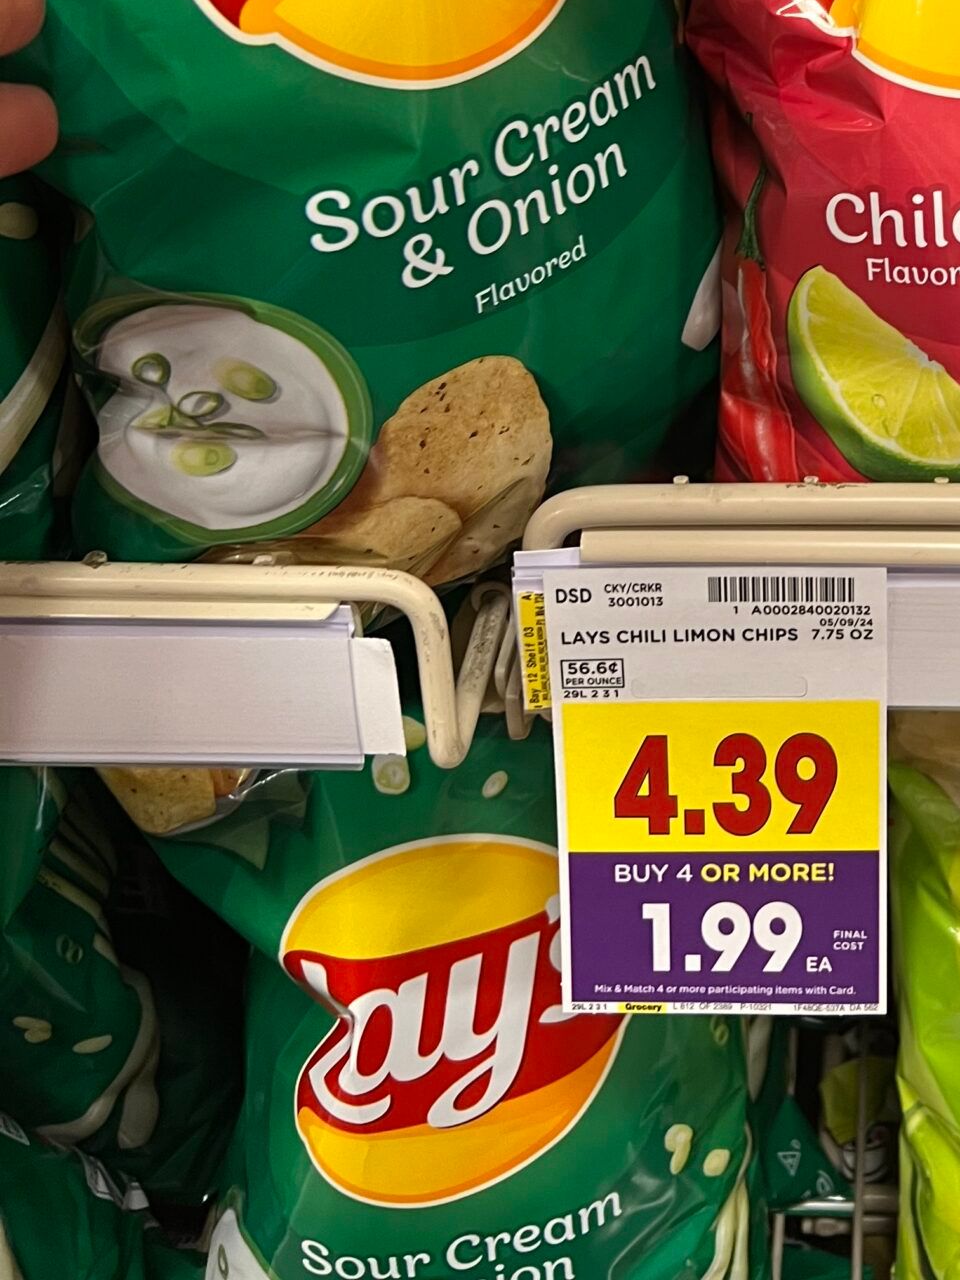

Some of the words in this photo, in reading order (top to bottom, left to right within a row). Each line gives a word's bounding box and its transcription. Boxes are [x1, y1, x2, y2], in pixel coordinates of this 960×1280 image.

[304, 158, 481, 254] Sour
[493, 54, 657, 178] Cream
[400, 231, 455, 290] &
[466, 141, 628, 257] Onion
[474, 233, 588, 315] Flavored
[604, 582, 662, 595] CKY/CRKR
[555, 588, 593, 604] DSD
[607, 596, 664, 608] 3001013
[732, 606, 738, 615] 1
[751, 605, 871, 616] A0002840020132
[819, 617, 873, 627] 05/09/24
[524, 626, 535, 638] 03
[561, 630, 611, 645] LAYS
[616, 629, 667, 644] CHILI
[673, 628, 736, 643] LIMON
[742, 627, 799, 642] CHIPS
[811, 627, 845, 641] 7.75
[849, 627, 874, 640] OZ
[523, 643, 537, 668] Shelf
[567, 662, 618, 675] 56.6¢
[527, 672, 538, 683] 12
[565, 677, 584, 685] PER
[587, 676, 622, 686] OUNCE
[529, 689, 541, 704] Bay
[563, 690, 587, 699] 29L
[591, 690, 598, 698] 2
[602, 690, 610, 698] 3
[613, 732, 839, 836] 4.39
[614, 864, 669, 883] BUY
[676, 863, 693, 882] 4
[701, 863, 740, 882] OR
[749, 862, 835, 882] MORE!
[641, 900, 803, 972] 1.99
[806, 956, 832, 972] EA
[833, 929, 867, 939] FINAL
[833, 941, 864, 951] COST
[594, 984, 612, 993] Mix
[615, 984, 622, 993] &
[624, 984, 655, 993] Match
[657, 984, 663, 993] 4
[679, 986, 706, 994] more
[708, 984, 773, 996] participating
[775, 985, 803, 994] items
[805, 985, 827, 994] with
[829, 985, 856, 995] Card.
[625, 1003, 663, 1012] Grocery
[300, 1239, 431, 1280] Sour
[446, 1191, 623, 1271] Cream
